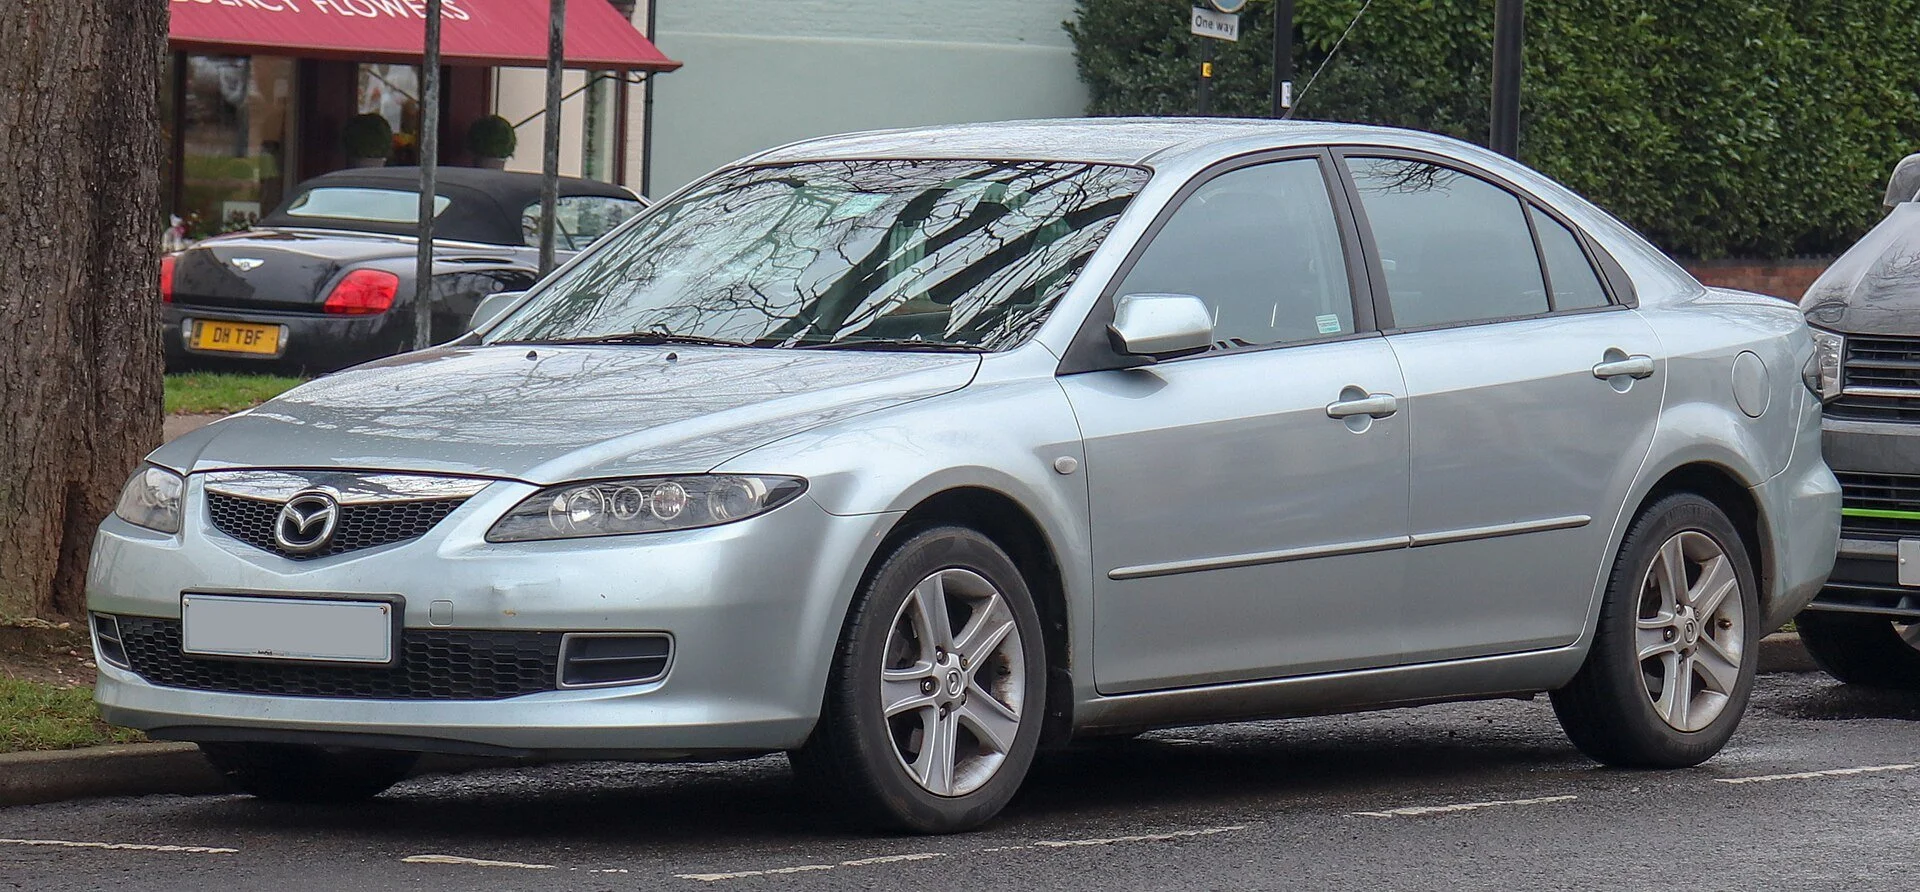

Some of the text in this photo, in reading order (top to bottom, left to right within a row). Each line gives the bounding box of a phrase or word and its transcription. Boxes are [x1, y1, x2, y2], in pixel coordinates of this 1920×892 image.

[1195, 15, 1235, 36] One way
[235, 328, 264, 345] TBF
